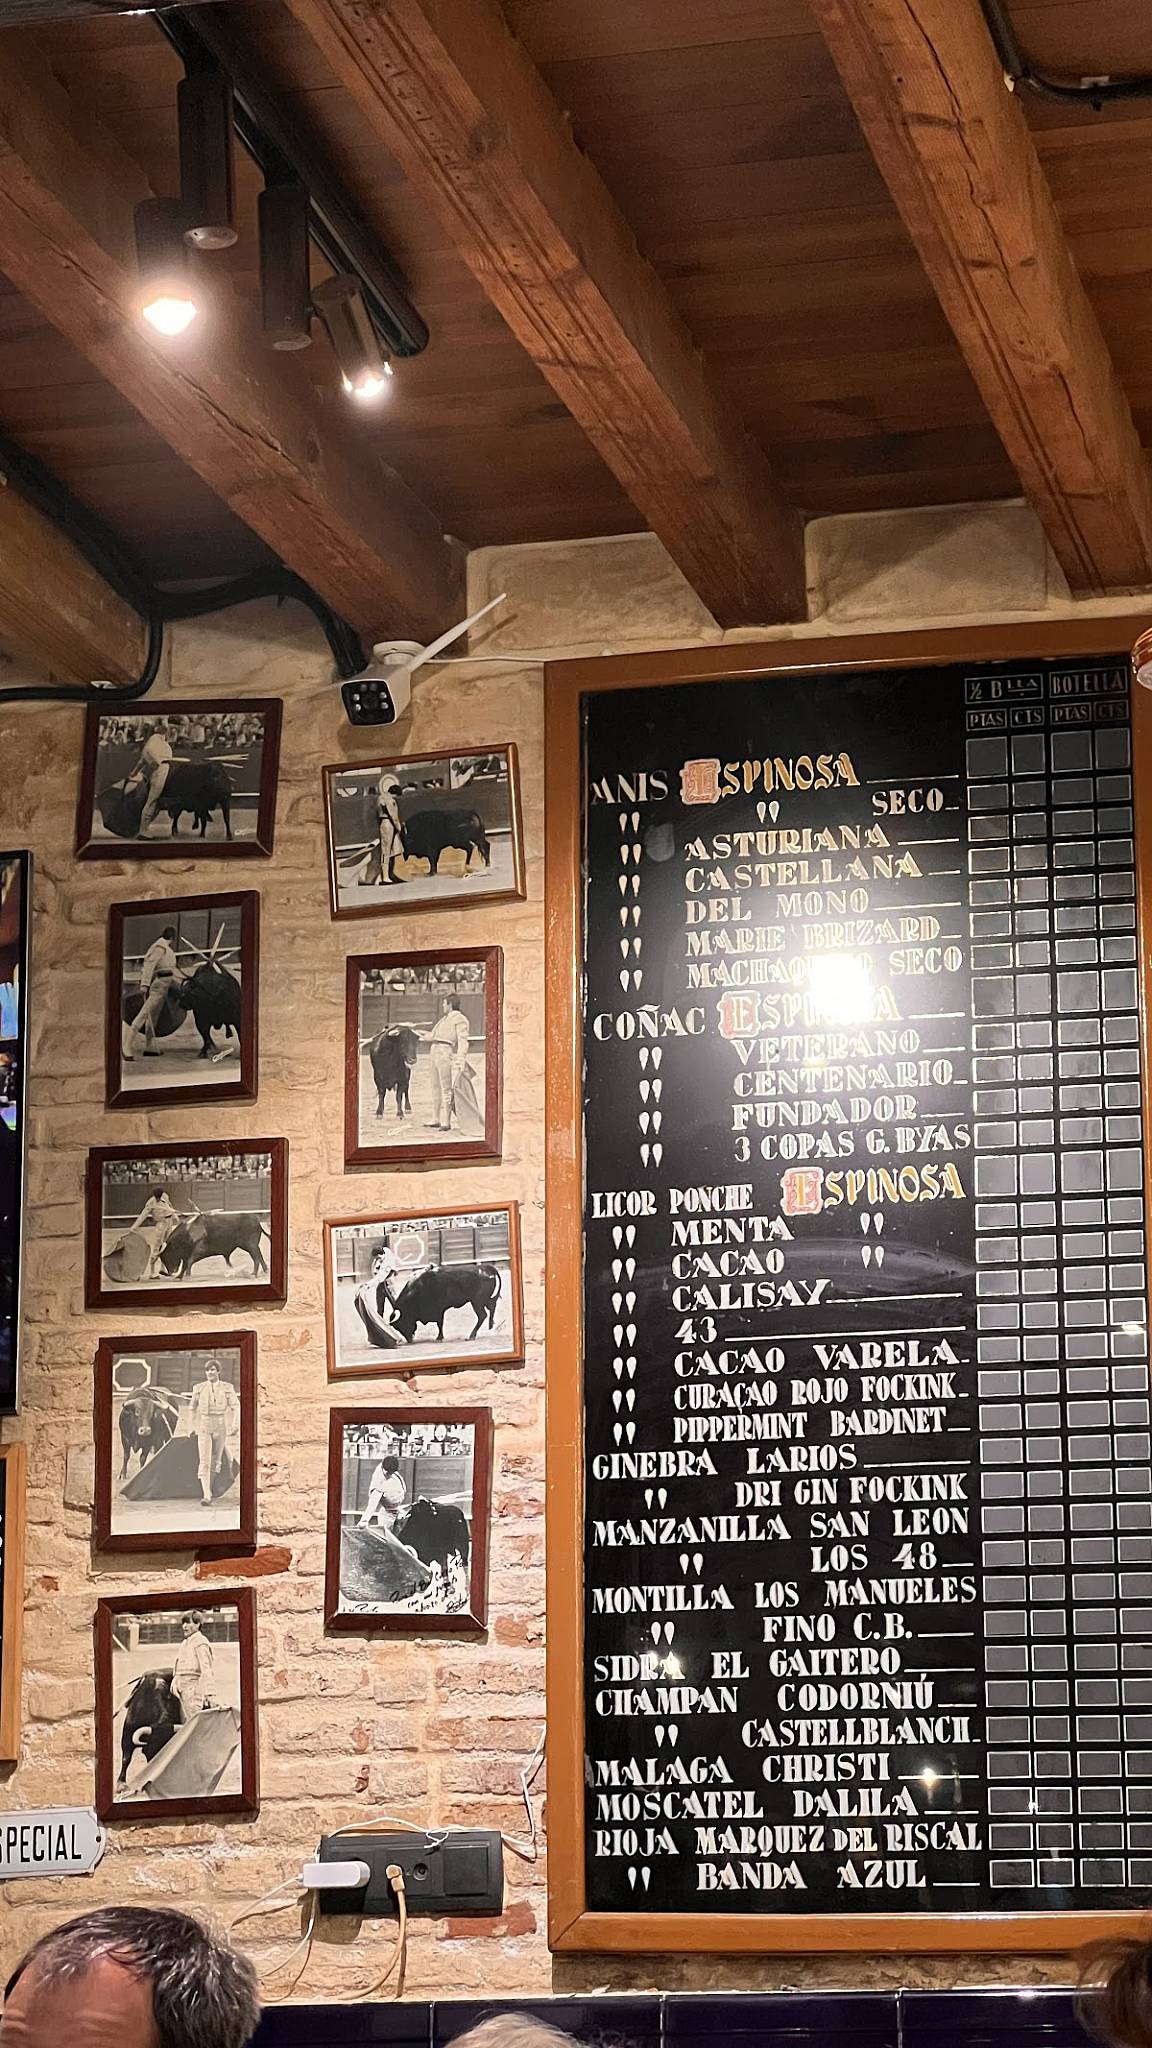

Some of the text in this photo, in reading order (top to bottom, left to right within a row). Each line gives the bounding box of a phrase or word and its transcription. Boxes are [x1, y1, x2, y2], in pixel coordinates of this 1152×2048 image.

[1053, 674, 1124, 694] BOTELLA
[970, 709, 1042, 727] PTAS CTS
[1054, 706, 1088, 721] PTAS
[591, 753, 860, 805] ANIS ESPINOSA
[871, 788, 944, 816] SECO
[684, 823, 890, 861] ASTURIANA
[685, 851, 923, 893] CASTELLANA
[686, 900, 752, 924] DEL
[776, 888, 869, 918] MONO
[686, 924, 786, 957] MARIE
[804, 916, 940, 948] BRIZARD
[889, 945, 963, 976] SECO
[593, 1004, 706, 1041] COÑAC
[731, 1029, 920, 1065] VETERANO
[733, 1059, 953, 1097] CENTENARIO
[732, 1095, 917, 1131] FUNDADOR
[734, 1137, 751, 1161] 3
[760, 1131, 854, 1160] COPAS
[591, 1162, 966, 1219] LICOR PONCHE ESPINOSA
[671, 1215, 795, 1246] MENTA
[671, 1248, 785, 1279] CACAO
[671, 1279, 833, 1312] CALISAY
[674, 1316, 718, 1345] 43
[674, 1347, 785, 1378] CACAO
[813, 1338, 960, 1371] VARELA
[674, 1380, 778, 1414] CURAÇAO
[791, 1379, 848, 1406] ROJO
[861, 1372, 957, 1401] FOCKINK
[674, 1412, 807, 1444] PIPPERMINT
[830, 1407, 947, 1438] BARDINET
[592, 1444, 858, 1480] GINEBRA LARIOS
[735, 1480, 781, 1508] DRI
[794, 1477, 839, 1505] GIN
[849, 1473, 969, 1503] FOCKINK
[592, 1507, 970, 1547] MANZANILLA SAN LEON
[811, 1543, 868, 1573] LOS
[891, 1541, 937, 1570] 48
[592, 1576, 977, 1615] MONTILLA LOS MANUELES
[762, 1613, 835, 1643] FINO
[853, 1613, 913, 1640] C.B.
[594, 1647, 900, 1682] SIDRA EL GAITERO
[596, 1685, 738, 1716] CHAMPAN
[741, 1716, 970, 1748] CASTELLBLANCH
[595, 1752, 890, 1787] MALAGA CHRISTI
[596, 1785, 919, 1823] MOSCATEL DALILA
[0, 1824, 81, 1864] PECIAL
[595, 1822, 983, 1857] RIOJA MARQUEZ DEL RISCAL
[697, 1859, 808, 1890] BANDA
[837, 1859, 926, 1889] AZUL
